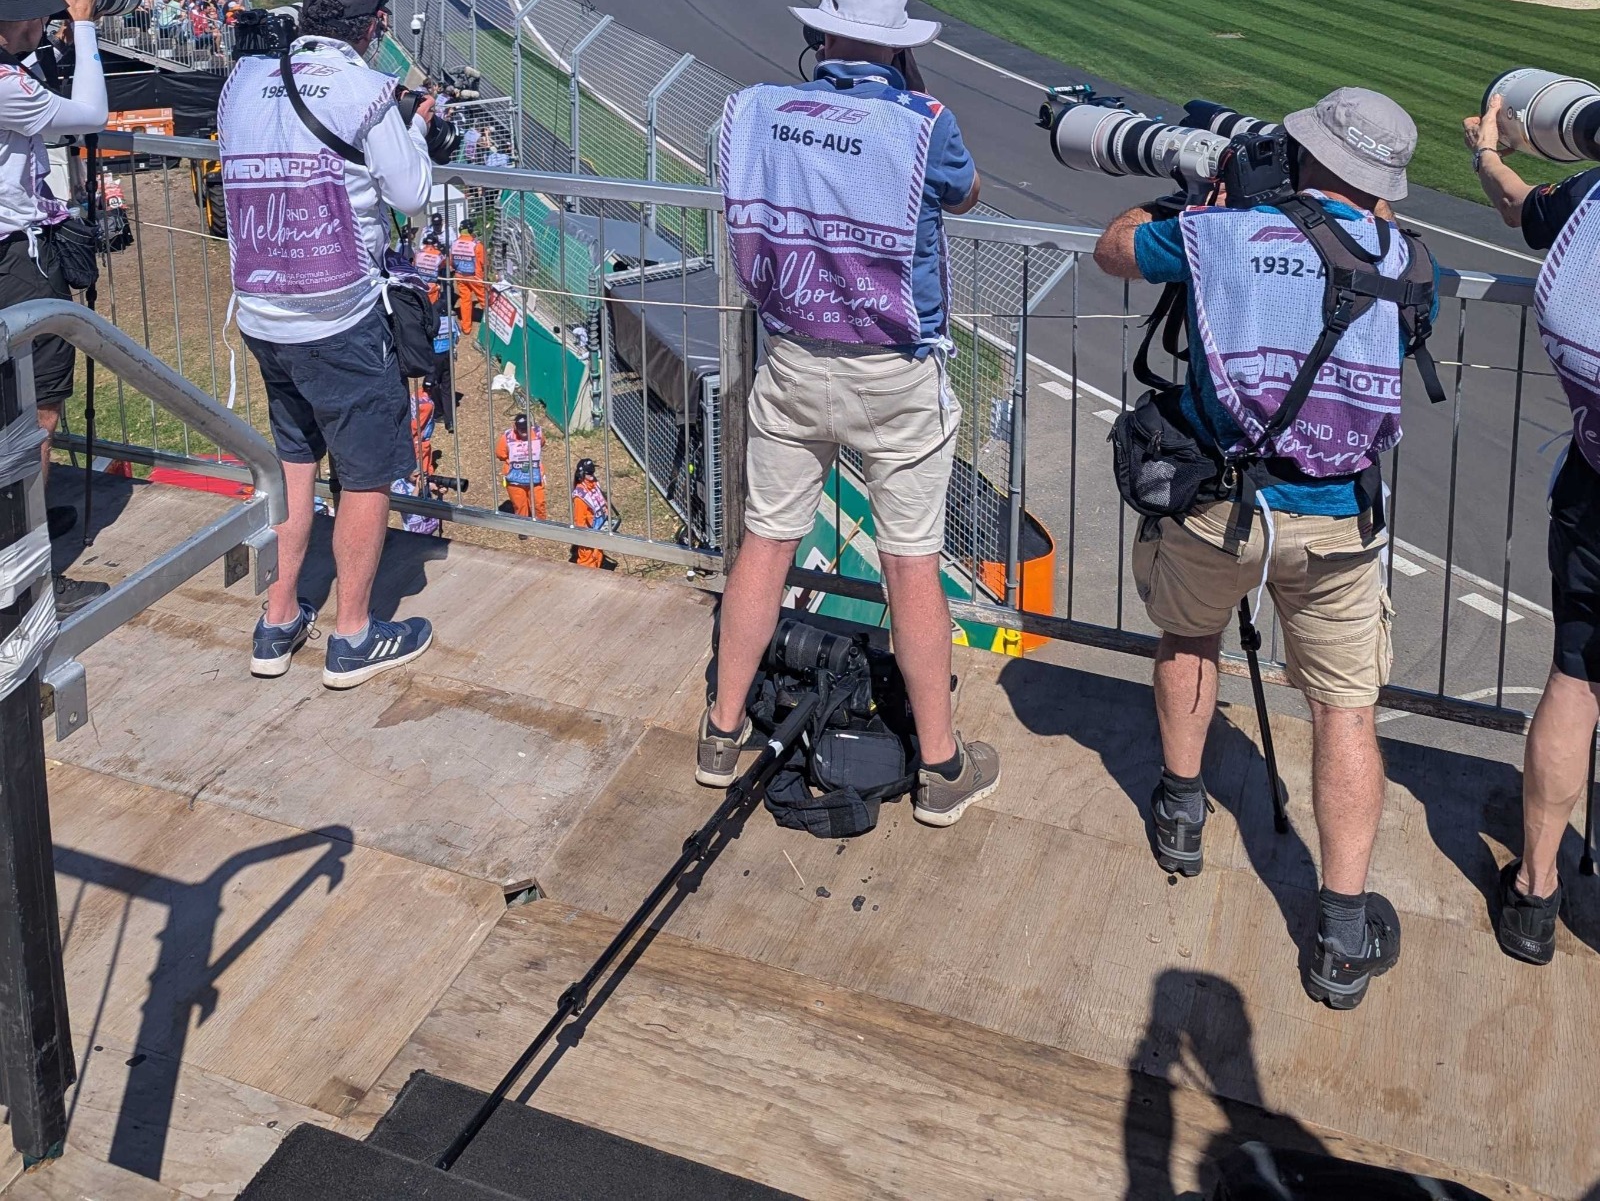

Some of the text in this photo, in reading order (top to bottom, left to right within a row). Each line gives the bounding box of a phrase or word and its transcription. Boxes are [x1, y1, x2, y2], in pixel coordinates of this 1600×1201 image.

[261, 83, 330, 99] 198AUS
[1054, 84, 1085, 92] PETROAS
[771, 123, 863, 156] 1846-AUS
[1347, 126, 1394, 157] CPS
[224, 155, 343, 180] MEDIA PHTO
[728, 202, 897, 249] MEDIA PHOTO
[1250, 256, 1327, 280] 1932-A
